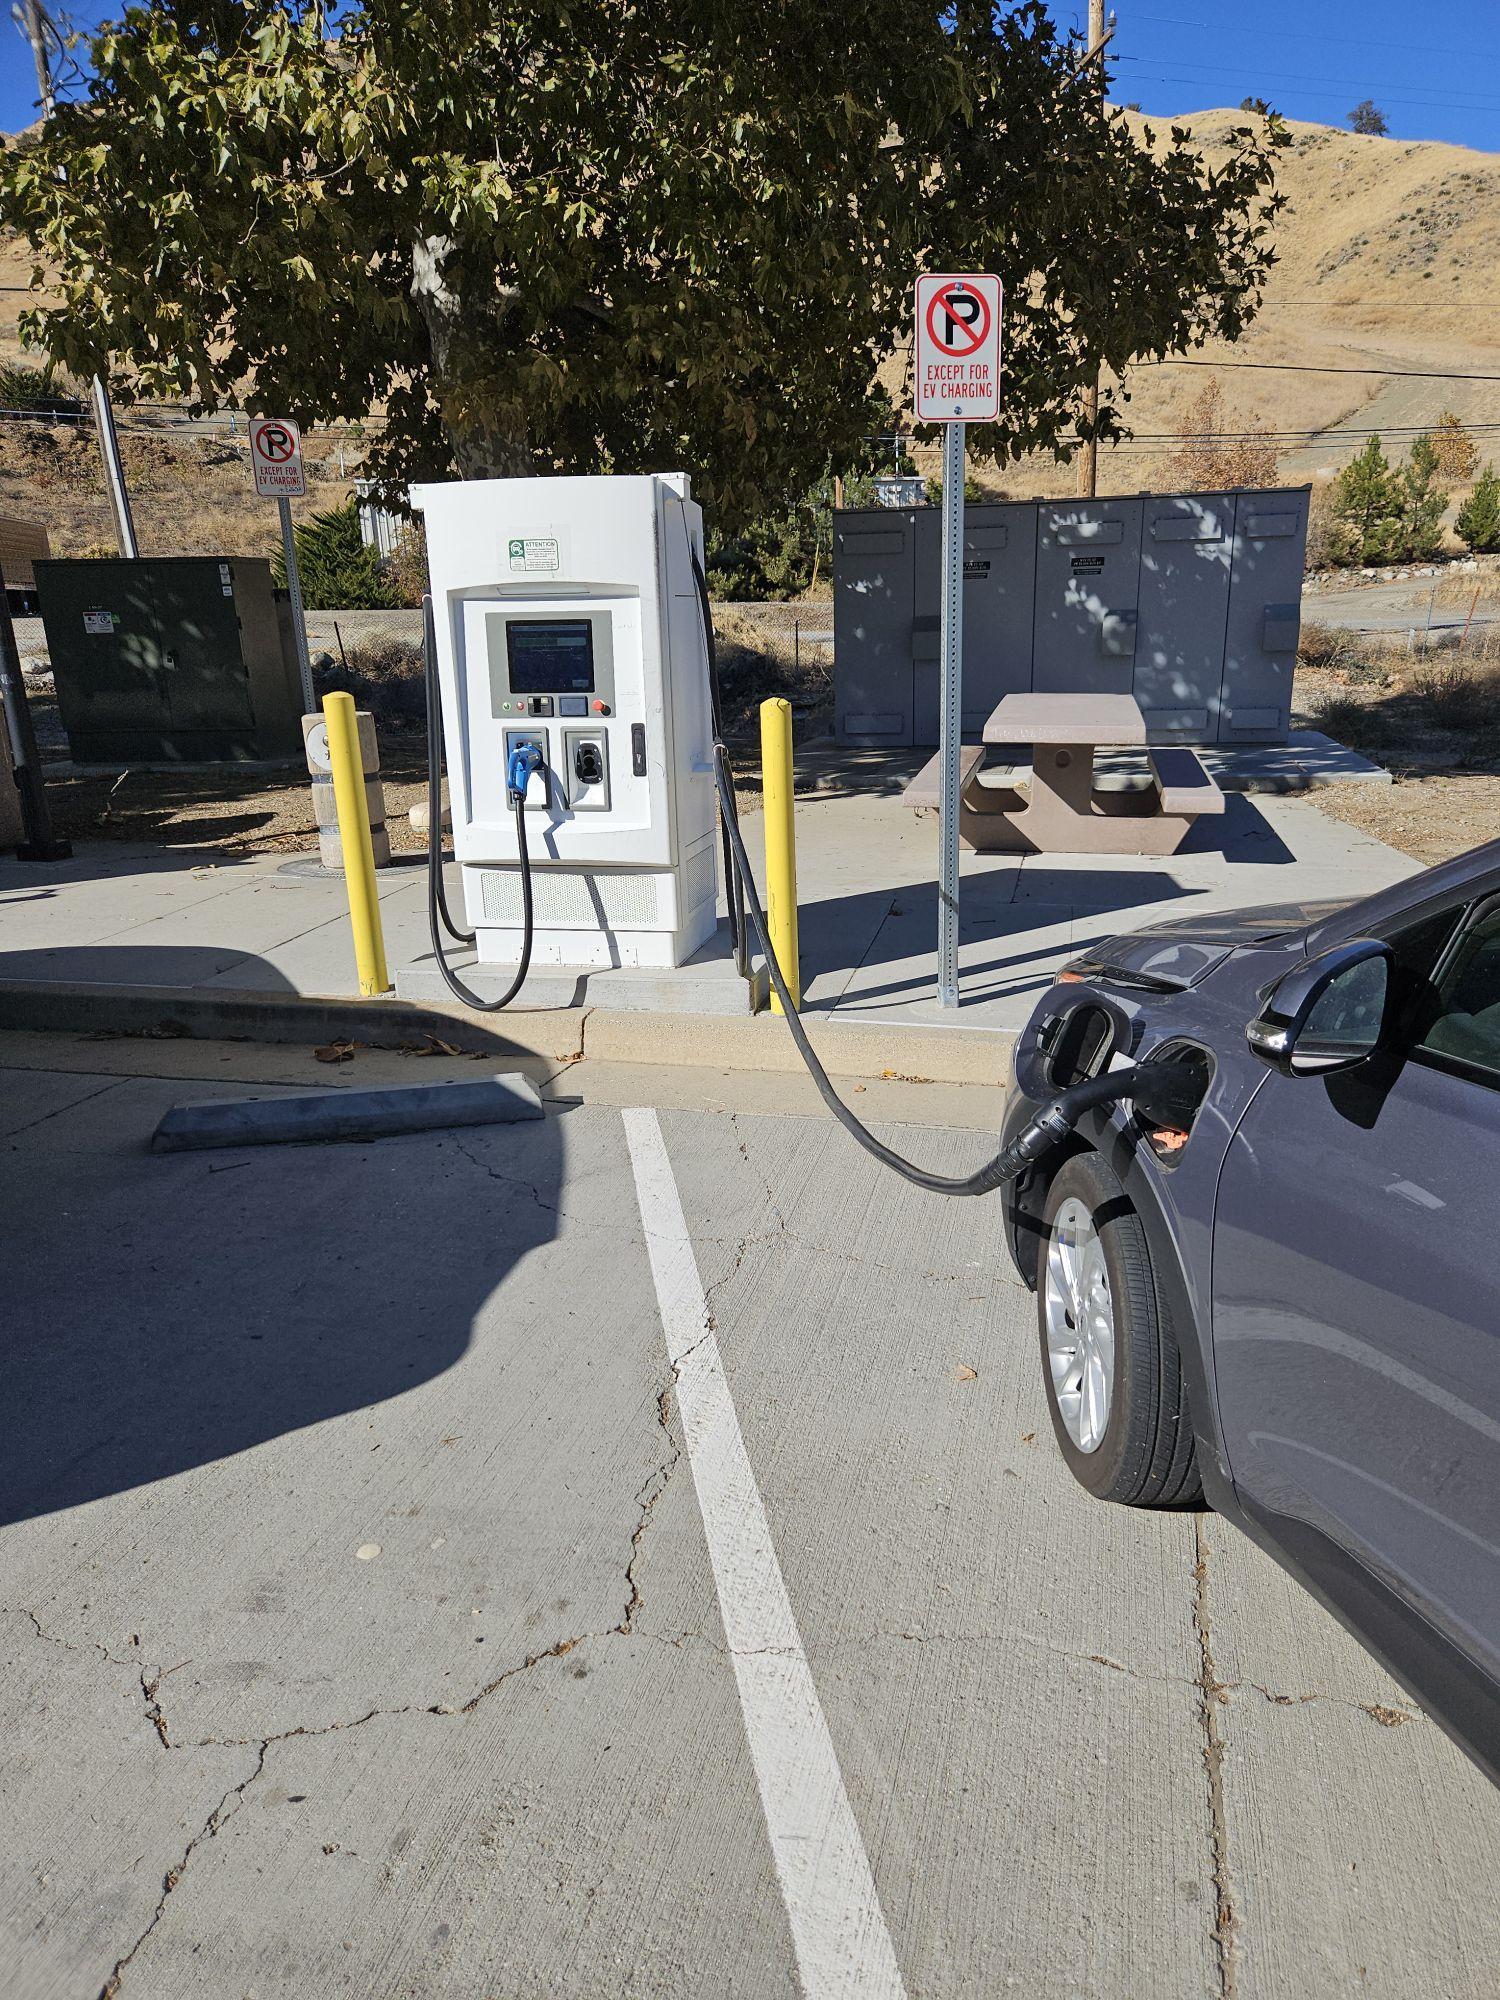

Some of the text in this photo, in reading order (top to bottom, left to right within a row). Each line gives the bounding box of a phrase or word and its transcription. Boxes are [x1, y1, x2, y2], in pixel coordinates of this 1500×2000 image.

[945, 294, 981, 345] P
[927, 364, 989, 380] EXCEPT FOR
[924, 382, 992, 398] EV CHARGING
[260, 466, 298, 475] EXCEPT FOR
[259, 476, 267, 484] EV
